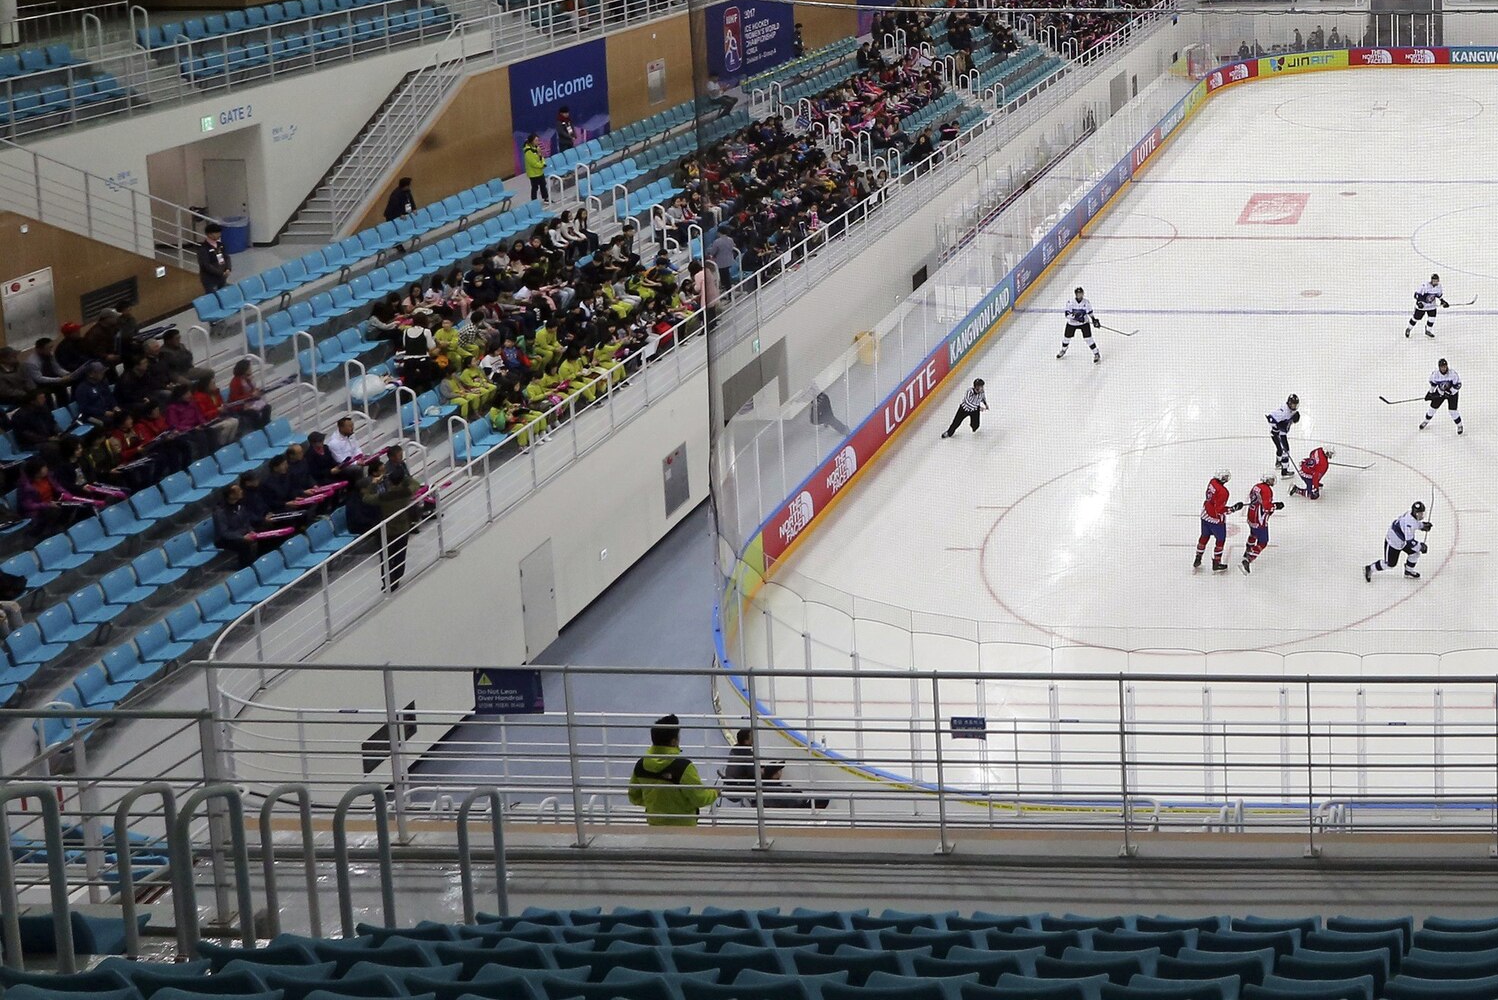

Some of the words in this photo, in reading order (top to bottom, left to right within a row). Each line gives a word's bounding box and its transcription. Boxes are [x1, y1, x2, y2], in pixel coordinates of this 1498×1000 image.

[530, 73, 593, 107] Welcome
[219, 107, 244, 125] GATE
[247, 105, 253, 118] 2
[1136, 132, 1156, 166] LOTTE
[950, 305, 990, 364] KANGWON
[990, 287, 1010, 318] LAND
[884, 359, 937, 434] LOTTE
[835, 448, 847, 467] THE
[827, 461, 849, 488] NORTH
[832, 471, 851, 496] FACE
[788, 496, 802, 516] THE
[780, 508, 804, 539] NORTH
[785, 520, 806, 545] FACE
